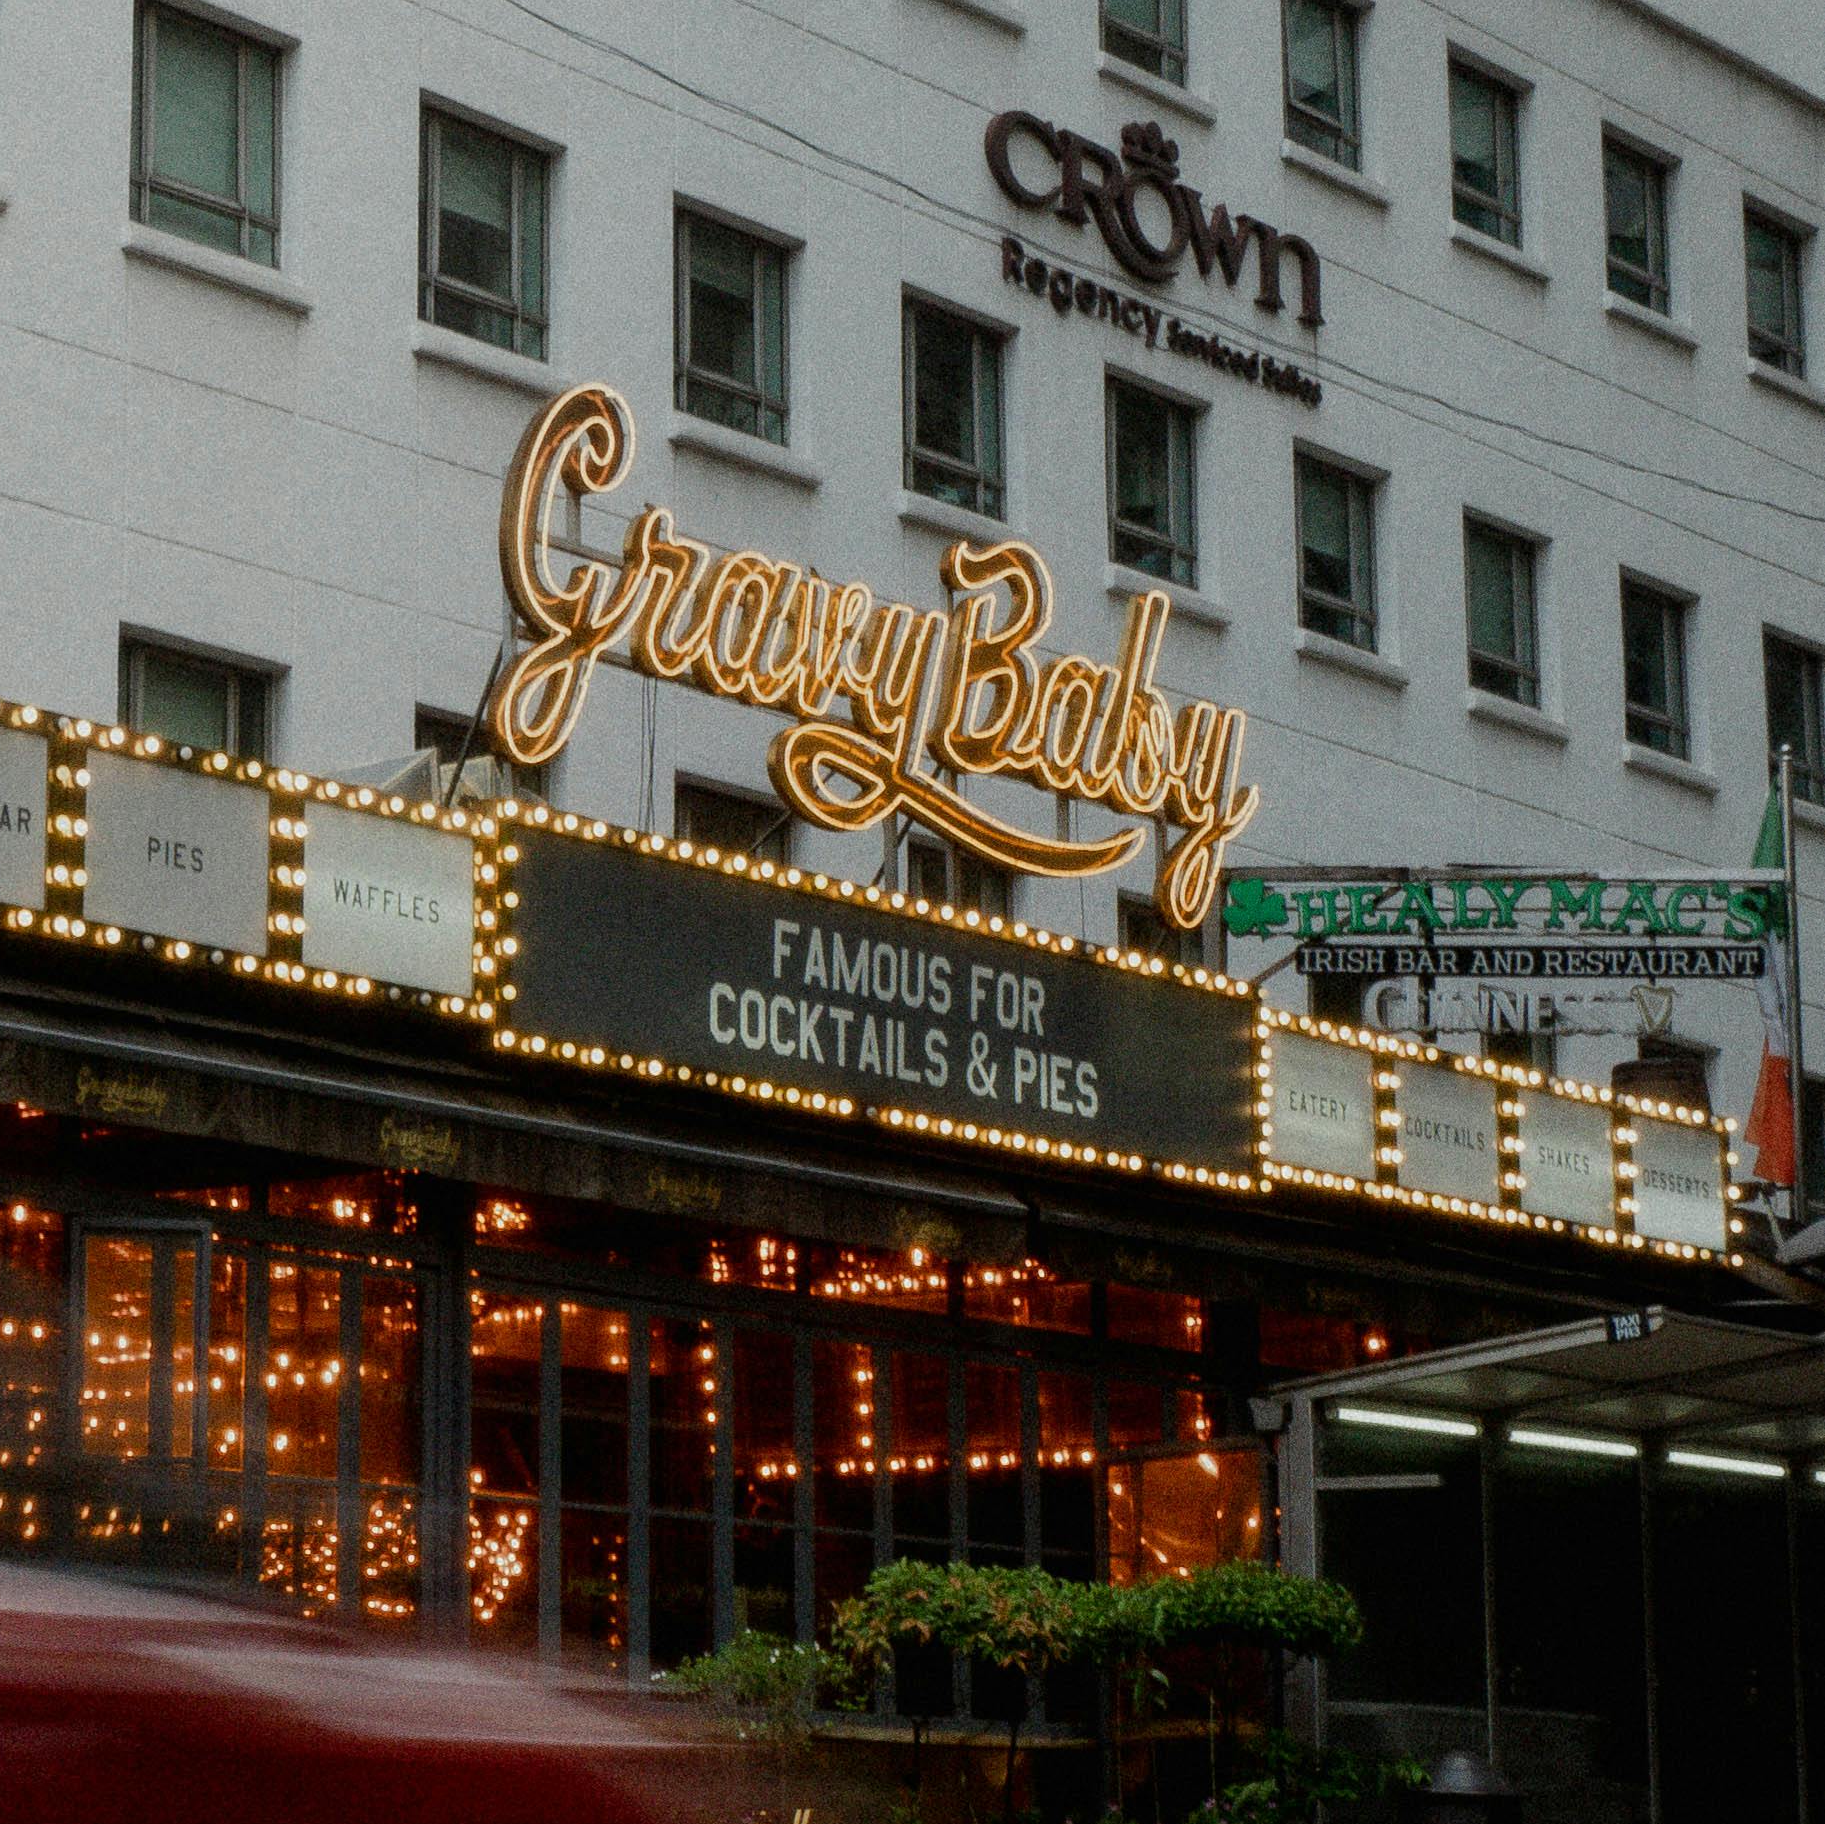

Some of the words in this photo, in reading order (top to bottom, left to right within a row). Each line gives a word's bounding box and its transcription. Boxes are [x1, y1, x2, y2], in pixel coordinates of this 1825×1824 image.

[1001, 236, 1162, 350] Regency
[146, 835, 205, 874] PIES
[333, 878, 441, 924] WAFFLES
[1292, 880, 1531, 938] HEALY
[1545, 879, 1768, 941] MAC'S
[773, 920, 953, 1018] FAMOUS
[970, 967, 1046, 1037] FOR
[1300, 947, 1386, 974] IRISH
[1395, 948, 1457, 974] BAR
[1471, 949, 1535, 975] AND
[1544, 950, 1759, 976] RESTAURANT
[708, 983, 949, 1091] COCKTAILS
[966, 1031, 998, 1099] &
[1012, 1047, 1100, 1119] PIES
[1289, 1091, 1349, 1122] EATERY
[1405, 1114, 1486, 1153] COCKTAILS
[1537, 1145, 1591, 1177] SHAKES
[1641, 1165, 1712, 1199] DESSERTS
[1612, 1313, 1641, 1327] TAXI
